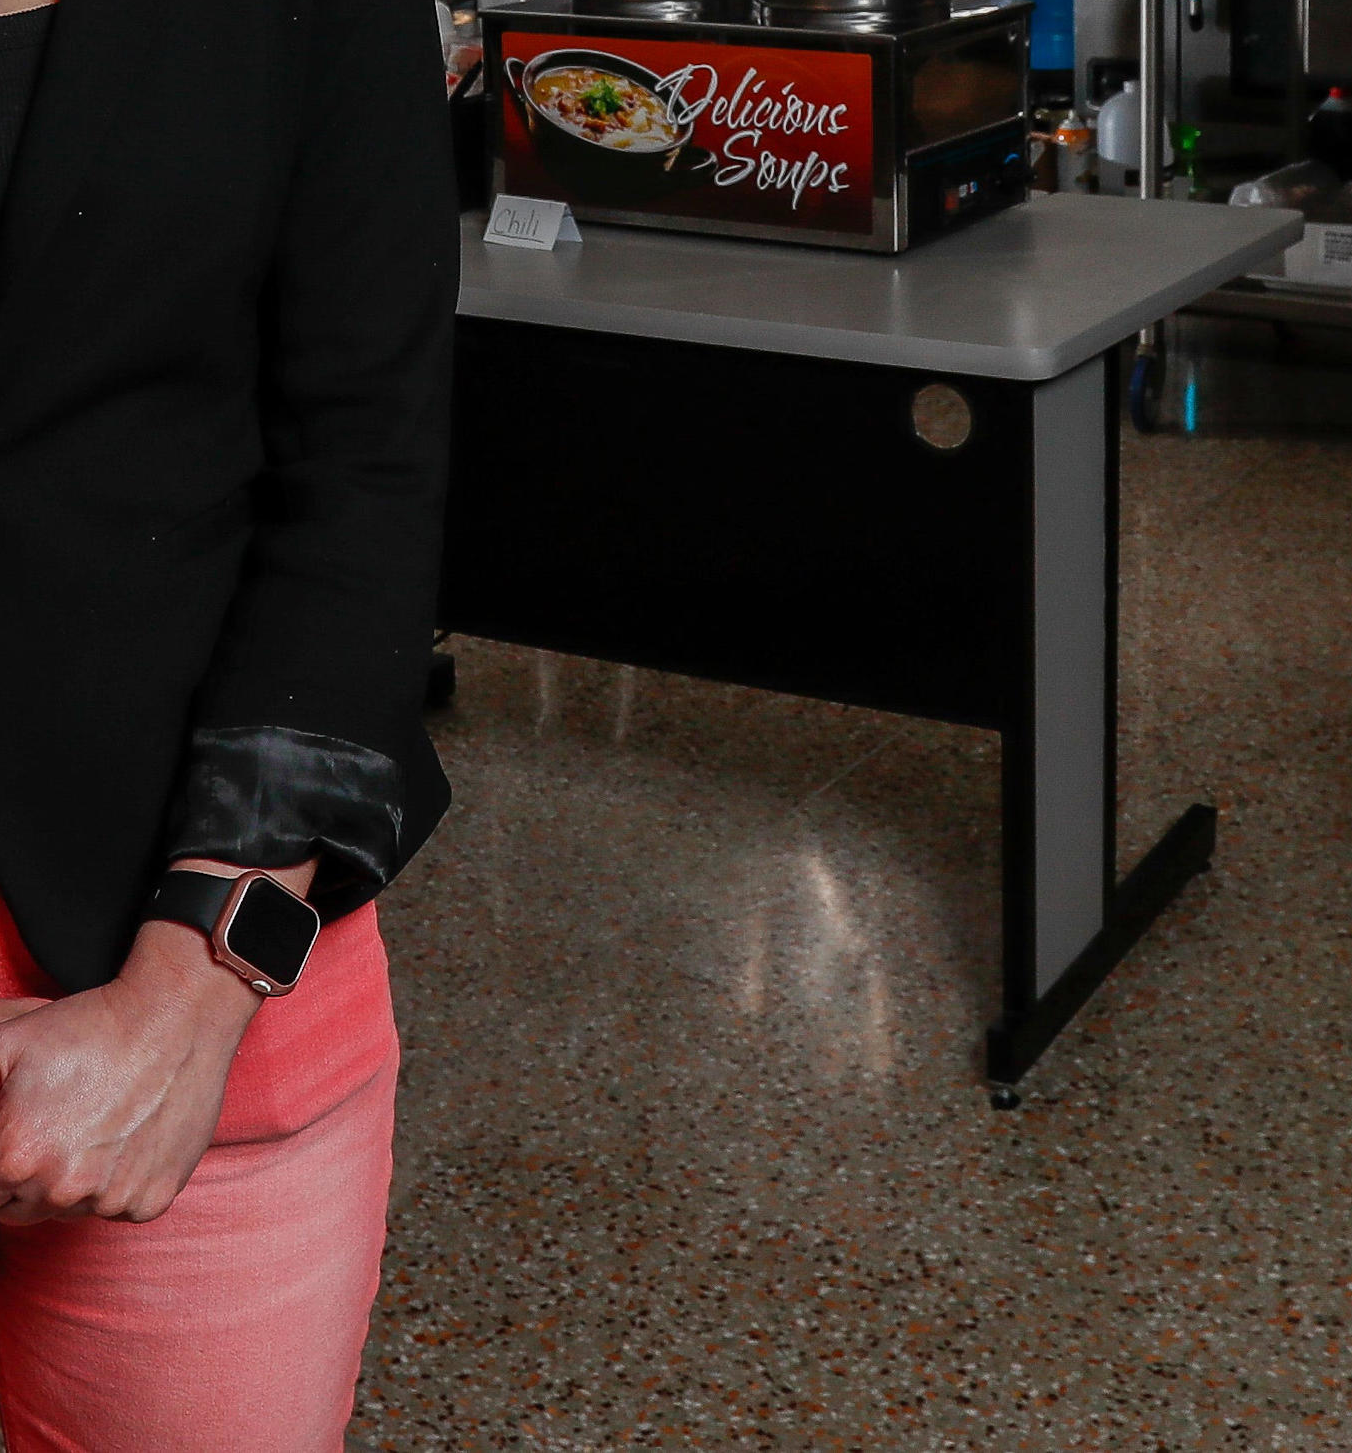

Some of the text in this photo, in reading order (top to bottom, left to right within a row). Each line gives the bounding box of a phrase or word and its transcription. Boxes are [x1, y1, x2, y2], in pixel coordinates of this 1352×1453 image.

[655, 64, 849, 135] Delicious
[714, 129, 850, 210] Soups
[493, 207, 540, 237] Chili
